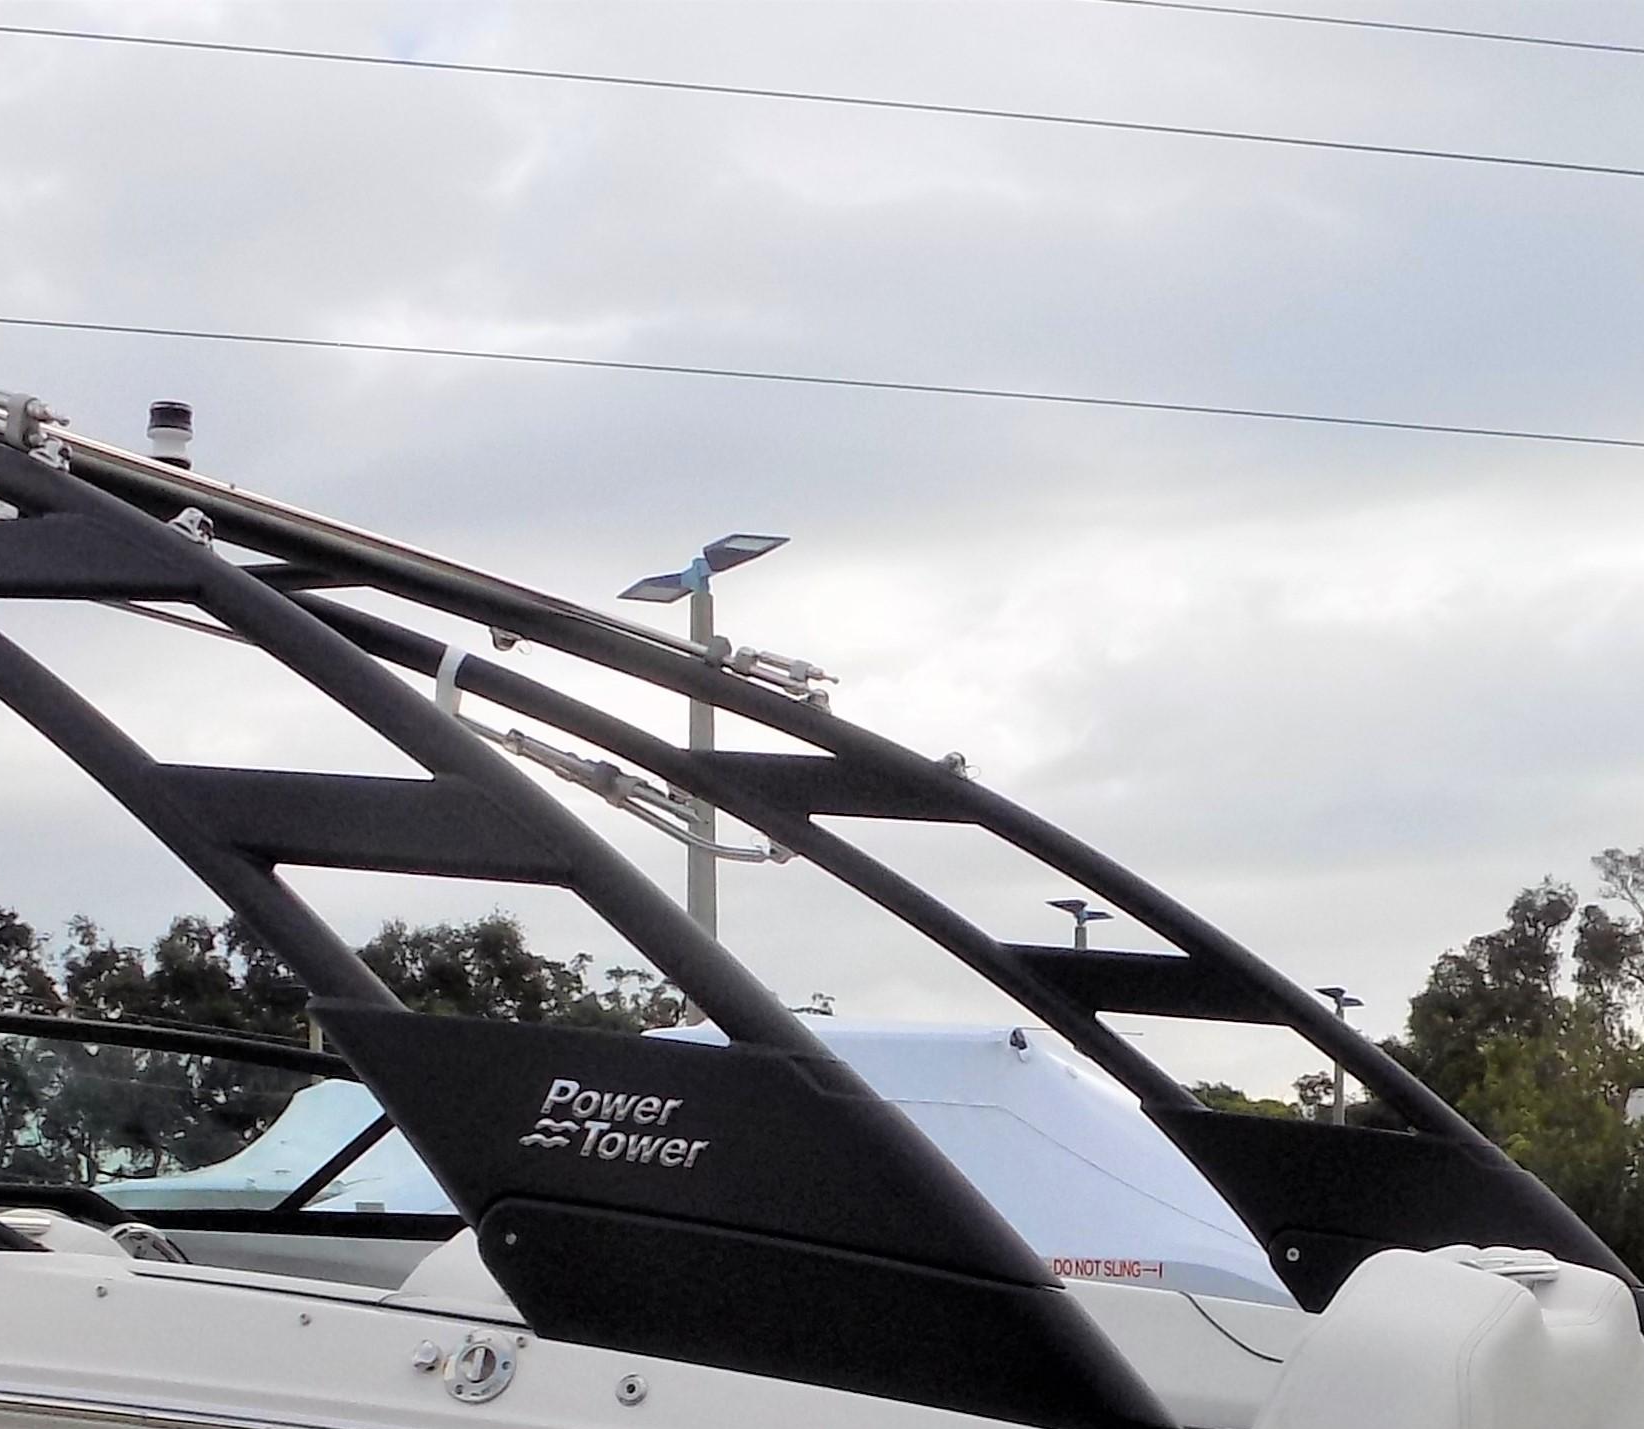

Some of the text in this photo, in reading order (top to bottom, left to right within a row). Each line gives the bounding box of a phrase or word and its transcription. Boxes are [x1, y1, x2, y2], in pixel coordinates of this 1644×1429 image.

[541, 1078, 684, 1126] Power
[579, 1120, 710, 1168] Tower
[1053, 1259, 1141, 1278] DO NOT SLING
